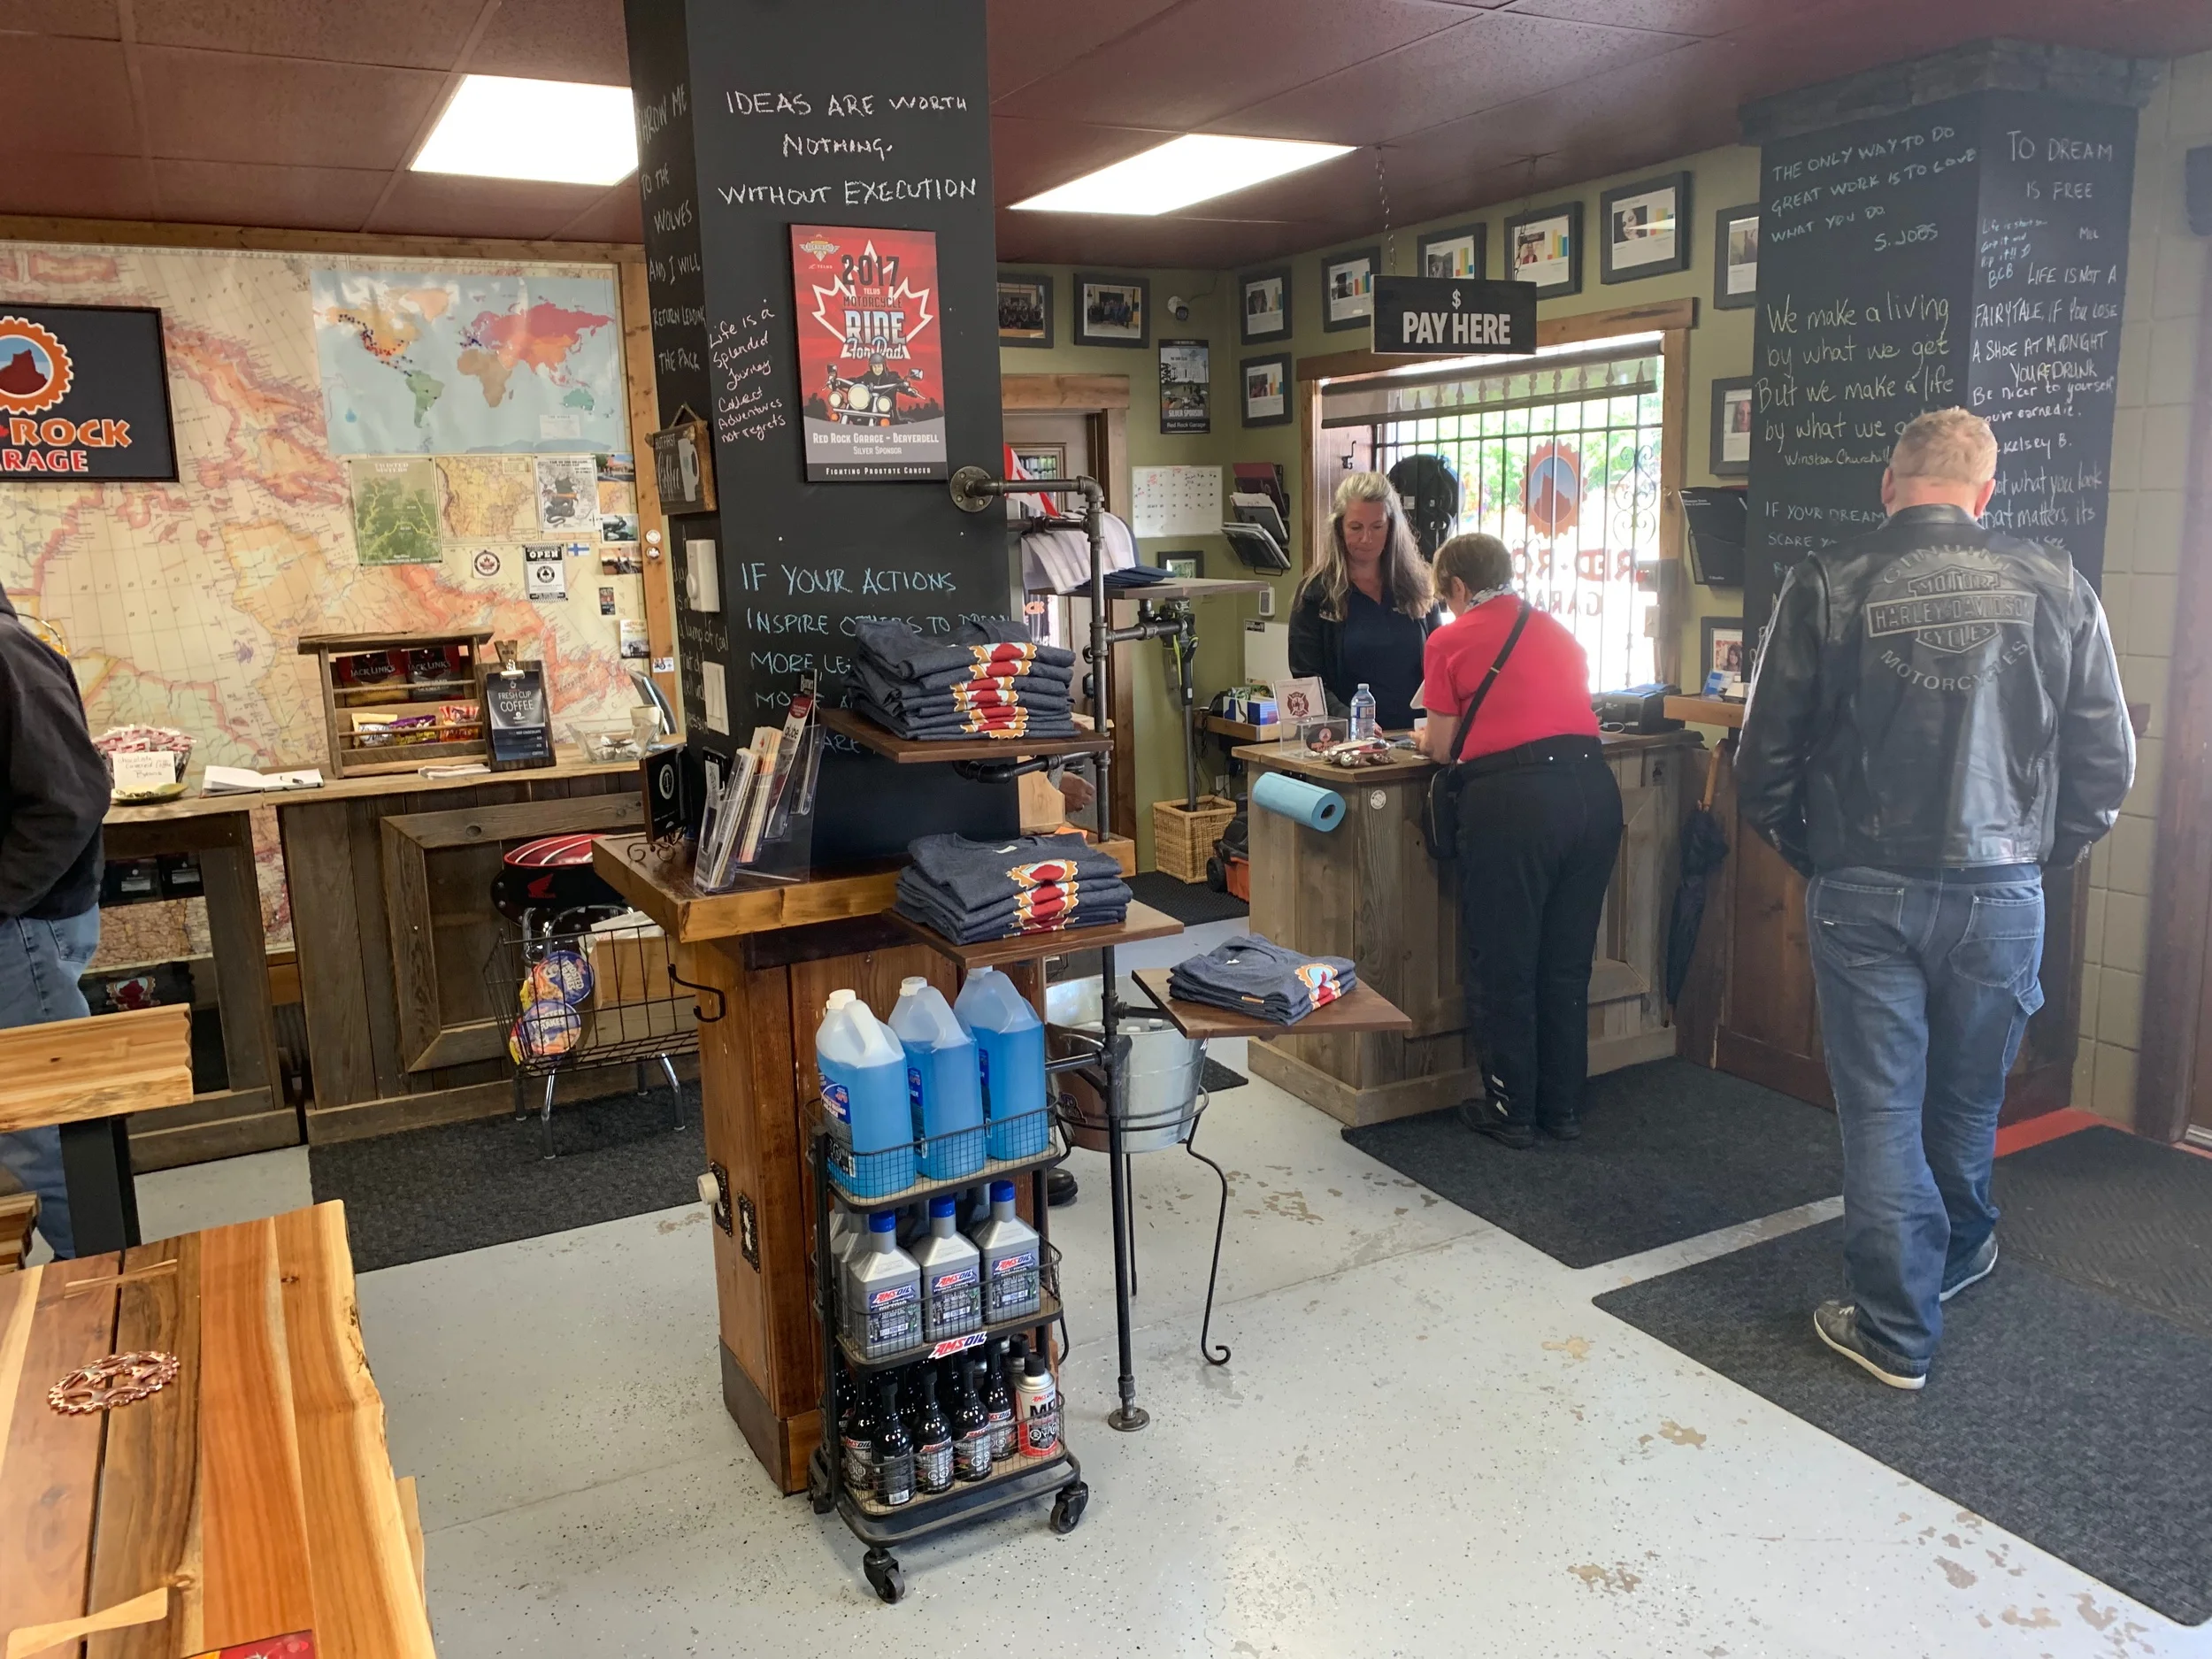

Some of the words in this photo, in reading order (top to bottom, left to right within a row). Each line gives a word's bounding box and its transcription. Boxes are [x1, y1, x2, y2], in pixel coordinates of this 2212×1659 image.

[672, 83, 687, 118] ME
[726, 90, 811, 116] IDEAS
[827, 94, 875, 117] ARE
[889, 96, 967, 111] WORTH
[1773, 161, 1802, 181] THE
[1809, 147, 1852, 171] ONLY
[1858, 139, 1897, 159] WAY
[1901, 135, 1924, 150] TO
[1932, 127, 1955, 141] DO
[2008, 130, 2034, 161] TO
[2049, 140, 2112, 161] DREAM
[641, 173, 652, 200] TO
[655, 162, 670, 189] THE
[718, 184, 832, 205] WITHOUT
[845, 178, 976, 205] EXECUTION
[1772, 188, 1822, 217] GREAT
[1830, 175, 1879, 196] WORK
[1888, 172, 1901, 185] IS
[1904, 164, 1927, 180] TO
[2027, 180, 2040, 198] IS
[2054, 180, 2093, 199] FREE
[654, 200, 692, 234] WOLVES
[1771, 221, 1814, 242] WHAT
[1825, 212, 1855, 229] YOU
[649, 257, 665, 282] AND
[669, 256, 675, 285] I
[678, 253, 701, 276] WILL
[841, 254, 900, 286] 2017
[2028, 262, 2056, 285] LIFE
[2064, 267, 2077, 283] IS
[2080, 265, 2101, 285] NOT
[2108, 264, 2116, 284] A
[843, 296, 902, 308] MOTORCYCLE
[1452, 288, 1461, 310] $
[2048, 299, 2062, 323] IF
[2093, 303, 2117, 319] LOSE
[653, 308, 680, 330] RETURN
[844, 310, 907, 344] RIDE
[1402, 311, 1448, 344] PAY
[1452, 311, 1510, 345] HERE
[1768, 294, 1797, 333] We
[1808, 298, 1857, 330] make
[1866, 307, 1880, 322] a
[1887, 291, 1948, 339] living
[710, 320, 737, 349] Life
[761, 308, 775, 319] a
[658, 349, 676, 374] THE
[678, 348, 700, 372] PACK
[1768, 345, 1792, 378] by
[1803, 334, 1857, 364] what
[1868, 343, 1901, 360] we
[1912, 336, 1949, 379] get
[1972, 340, 1981, 363] A
[1985, 339, 2018, 361] SHOE
[2024, 337, 2043, 357] AT
[2052, 358, 2098, 380] DRUNK
[1755, 377, 1798, 413] But
[1807, 380, 1837, 402] we
[1846, 374, 1896, 400] make
[1905, 380, 1917, 393] a
[1925, 365, 1954, 401] life
[9, 418, 132, 448] ROCK
[813, 433, 828, 443] RED
[831, 433, 851, 443] ROCK
[1766, 420, 1784, 453] by
[1796, 411, 1847, 439] what
[1855, 421, 1886, 437] we
[0, 449, 88, 472] RAGE
[853, 446, 873, 455] SILVER
[875, 446, 902, 455] SPONSOR
[1785, 450, 1834, 466] Winston
[1837, 448, 1890, 465] Churchill
[2012, 466, 2047, 496] what
[1766, 501, 1779, 518] IF
[1787, 505, 1823, 520] YOUR
[1769, 532, 1813, 547] SCARE
[530, 549, 558, 558] OPEN
[741, 562, 766, 591] IF
[781, 563, 853, 595] YOUR
[863, 567, 956, 595] ACTIONS
[1920, 572, 1997, 592] MOTOR
[747, 607, 829, 636] INSPIRE
[926, 617, 950, 634] TO
[1875, 595, 2032, 631] HARLEY-DAVIDSO
[1924, 622, 1991, 649] CYCLES
[350, 666, 371, 678] JACK
[408, 662, 428, 672] JACK
[498, 691, 517, 700] FRESH
[518, 690, 531, 699] CUP
[500, 700, 534, 712] COFFEE
[995, 1253, 1031, 1271] AMSOIL
[934, 1269, 973, 1288] AMSOIL
[872, 1285, 912, 1304] AMSOIL
[928, 1331, 987, 1359] AMSOIL
[1031, 1390, 1054, 1402] AMSOIL
